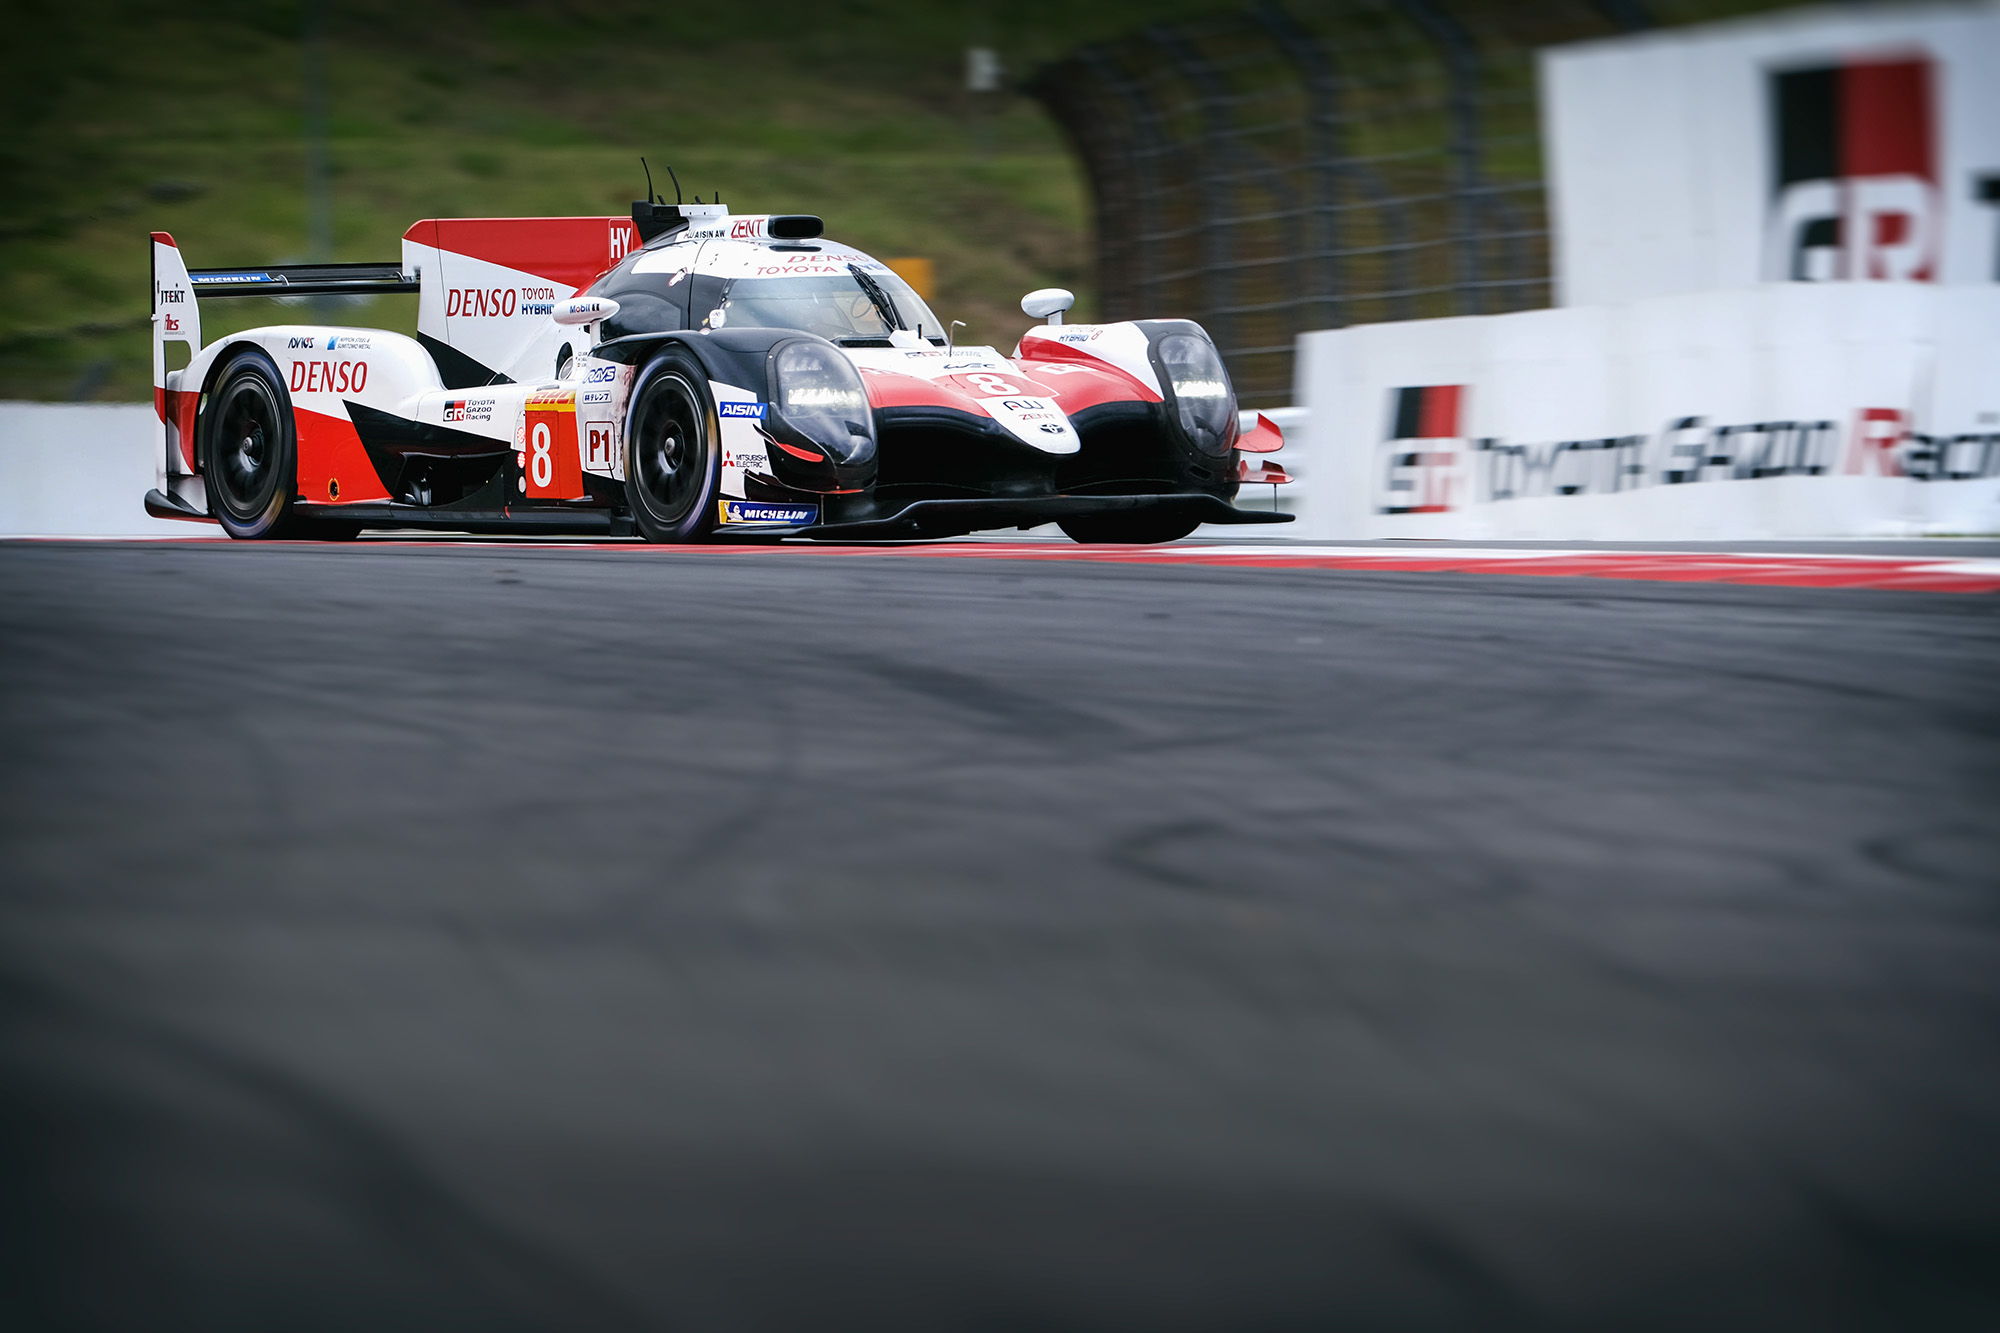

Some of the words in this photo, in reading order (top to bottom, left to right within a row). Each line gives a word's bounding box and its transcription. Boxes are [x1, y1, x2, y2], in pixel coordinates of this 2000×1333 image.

[695, 231, 713, 239] AISIN
[715, 230, 725, 238] AW
[731, 219, 765, 238] ZENT
[610, 227, 631, 258] HY
[787, 254, 870, 264] DENSO
[757, 265, 838, 276] TOYOTA
[160, 290, 185, 305] JTEKT
[521, 288, 555, 300] TOYOTA
[446, 288, 517, 317] DENSO
[569, 303, 590, 314] Mobil
[290, 361, 368, 393] DENSO
[582, 366, 616, 384] RAYS
[965, 373, 1021, 396] 8
[531, 391, 570, 404] DHL
[444, 408, 464, 420] GR
[721, 405, 763, 416] AISIN
[465, 414, 491, 422] Racing
[589, 429, 609, 462] P1
[531, 422, 552, 488] 8
[736, 454, 767, 462] MITSUBISHI
[736, 460, 763, 468] ELECTRIC
[744, 509, 808, 520] MICHELIN
